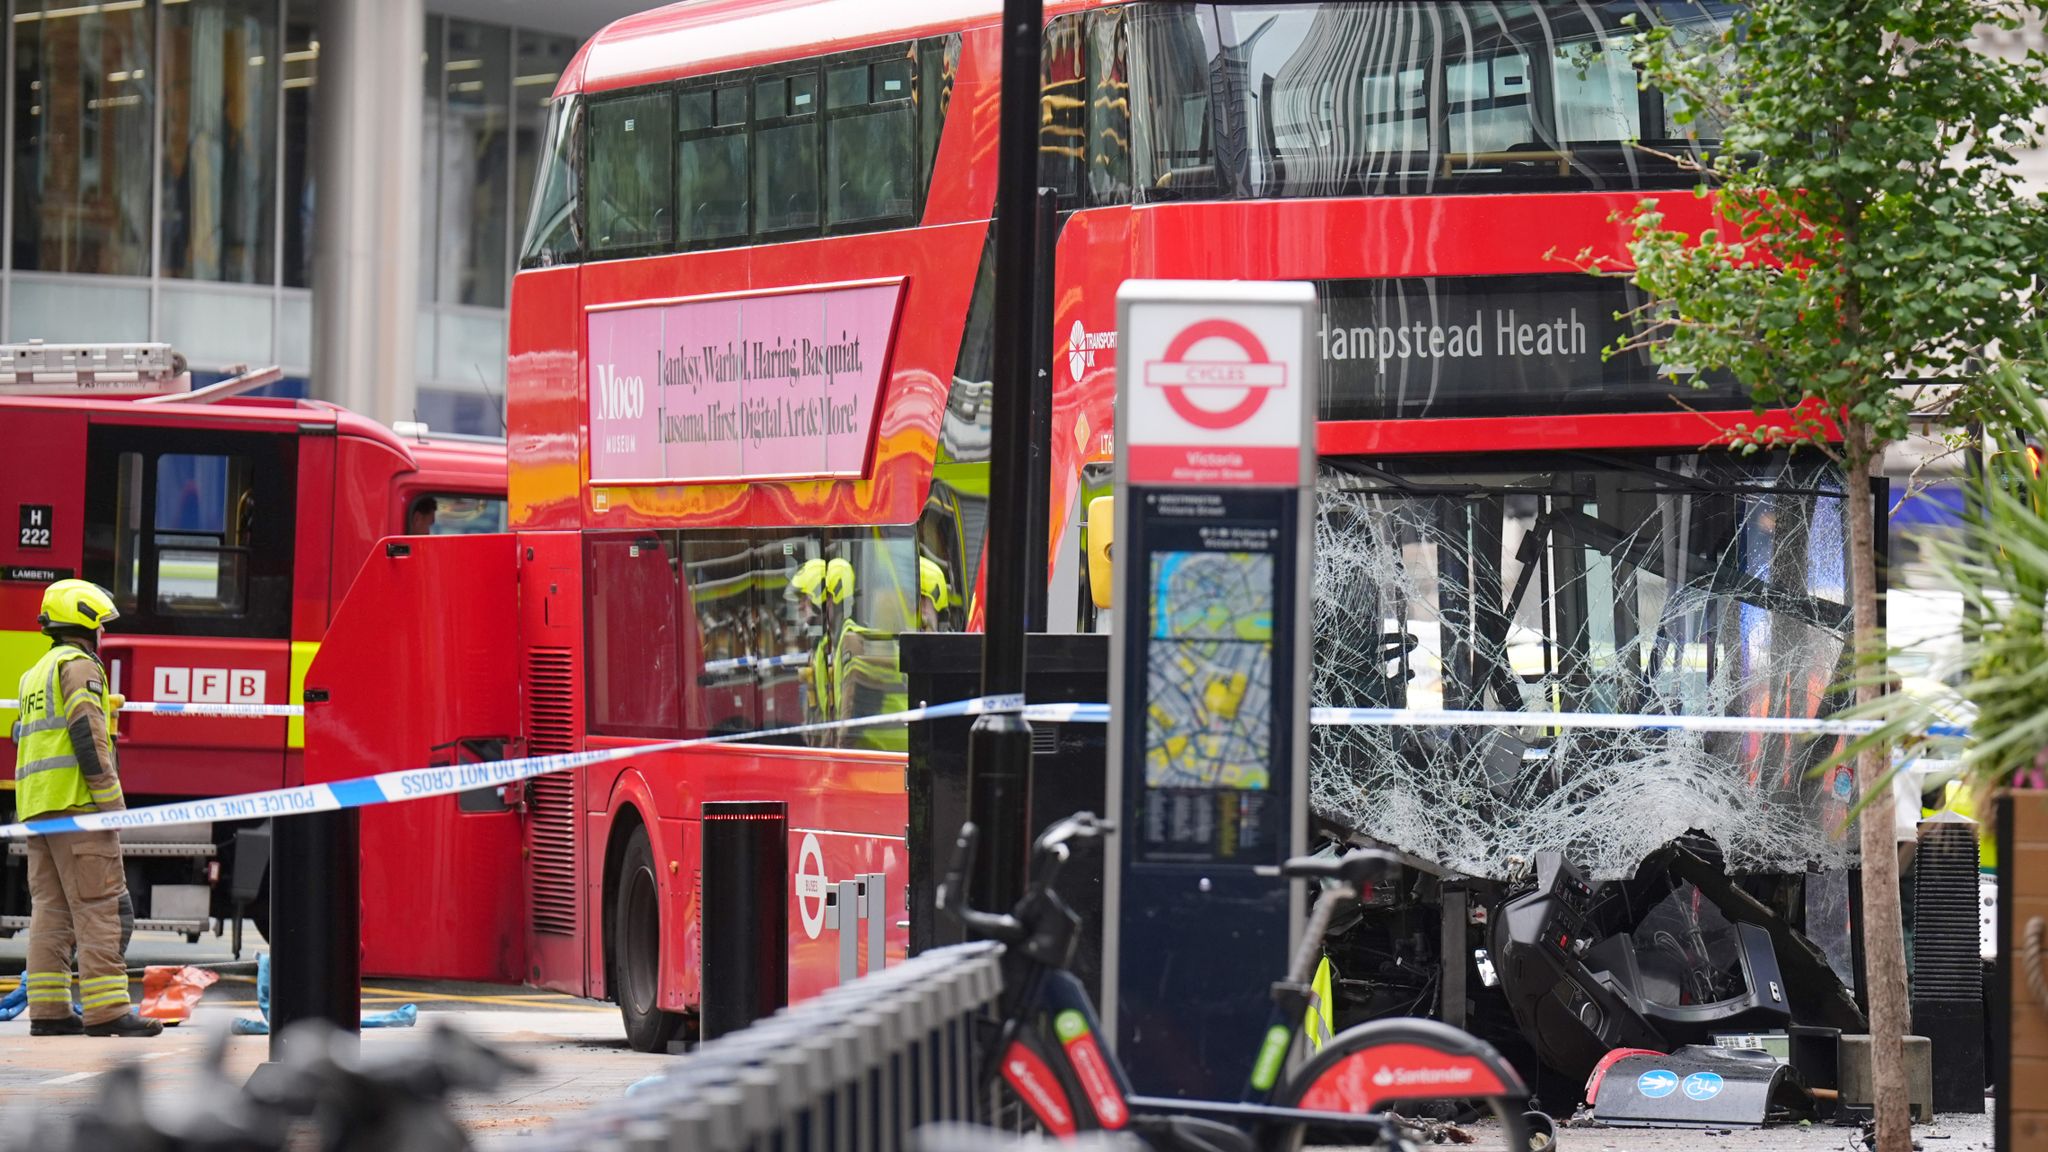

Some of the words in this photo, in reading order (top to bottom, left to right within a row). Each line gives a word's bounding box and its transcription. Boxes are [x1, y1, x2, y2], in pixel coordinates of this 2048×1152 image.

[1497, 307, 1586, 355] Heath
[753, 335, 800, 388] Haring,
[1086, 350, 1095, 367] UK
[1186, 366, 1246, 382] CYCLES
[596, 363, 645, 420] Moco
[741, 395, 782, 449] Digital
[606, 434, 636, 453] MUSEUM
[1186, 450, 1243, 467] Victoria
[30, 509, 42, 526] H
[21, 528, 50, 545] 222
[12, 569, 54, 580] LAMBETH
[459, 764, 489, 786] NOT
[494, 761, 515, 779] DO
[401, 770, 454, 796] CROSS
[225, 801, 256, 817] LINE
[264, 791, 316, 812] POLICE
[160, 807, 190, 822] NOT
[194, 804, 216, 818] DO
[1392, 1066, 1474, 1084] Santander
